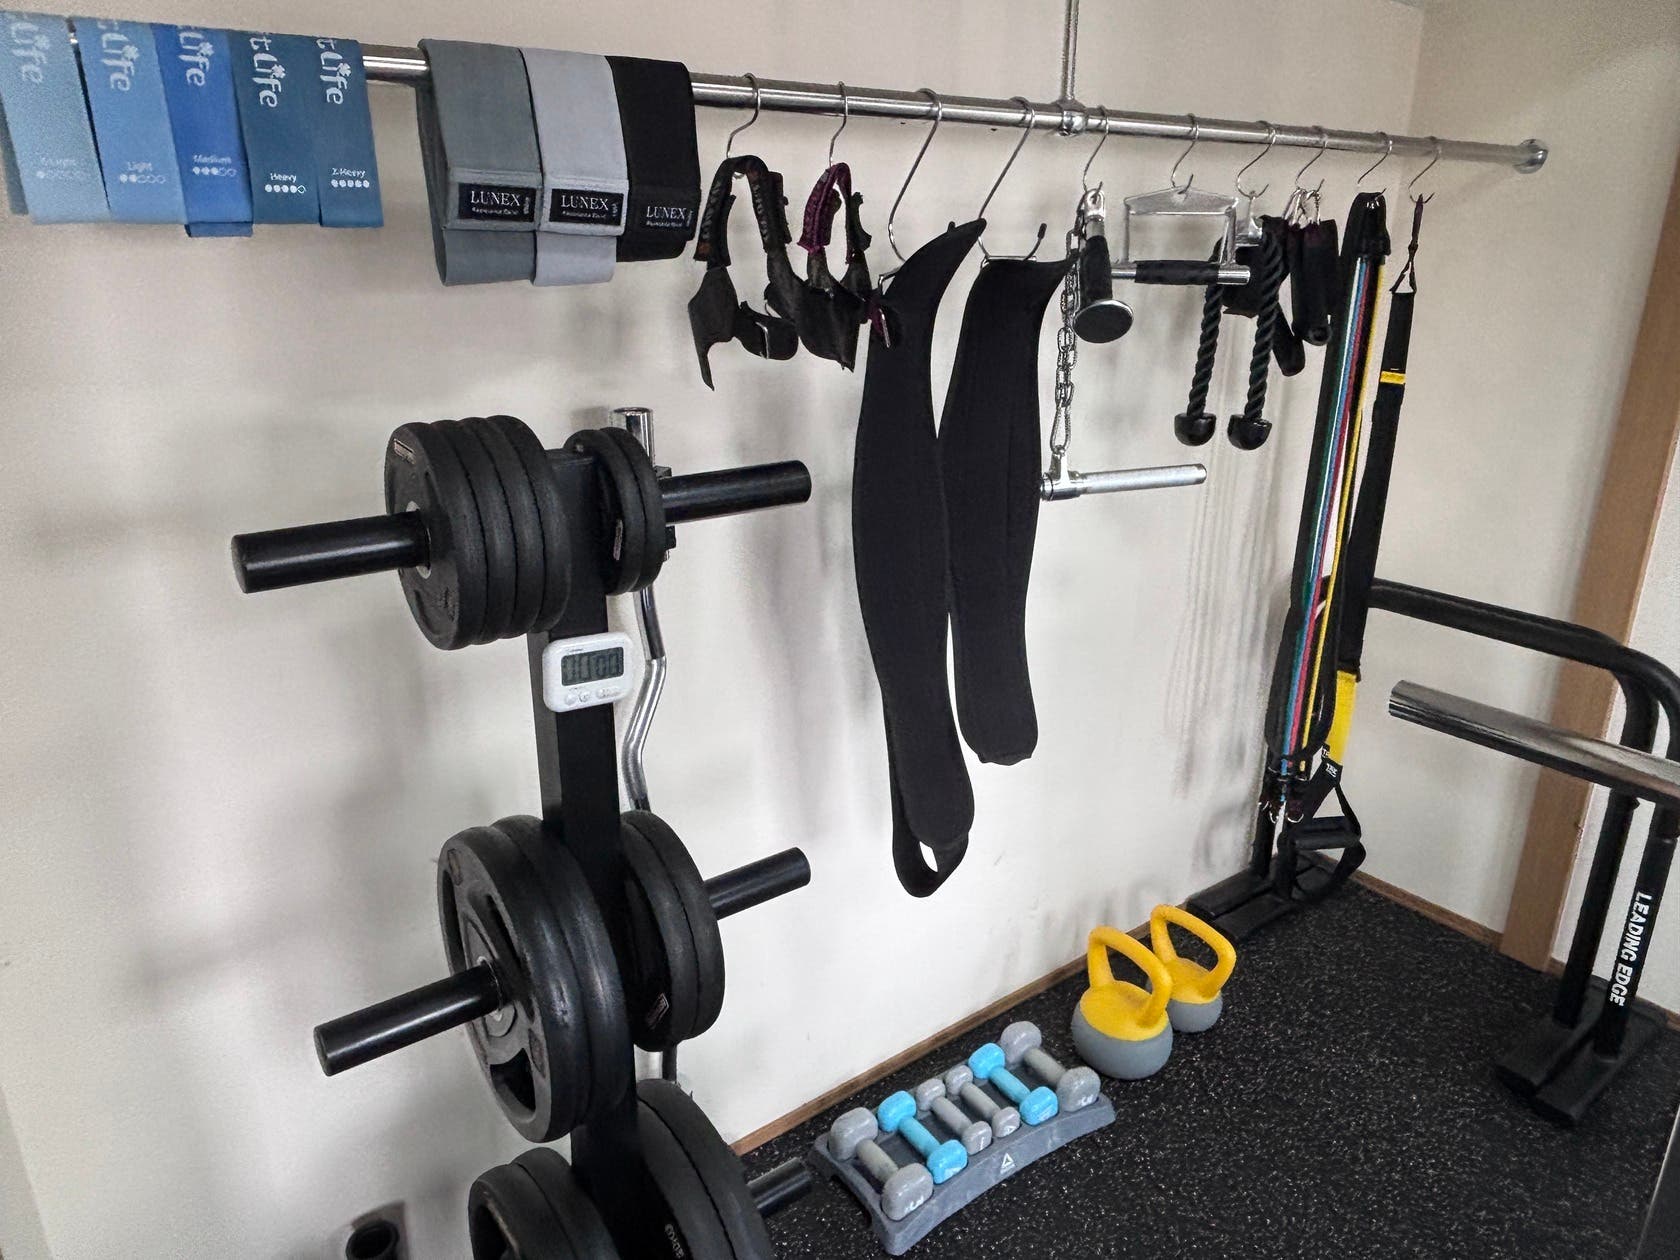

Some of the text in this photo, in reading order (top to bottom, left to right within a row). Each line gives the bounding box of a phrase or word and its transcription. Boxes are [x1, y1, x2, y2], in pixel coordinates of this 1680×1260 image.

[270, 172, 297, 184] Heavy
[470, 190, 521, 207] LUNEX
[560, 194, 609, 211] LUNEX
[646, 205, 687, 220] LUNEX
[1609, 891, 1653, 1007] LEADING EDGE
